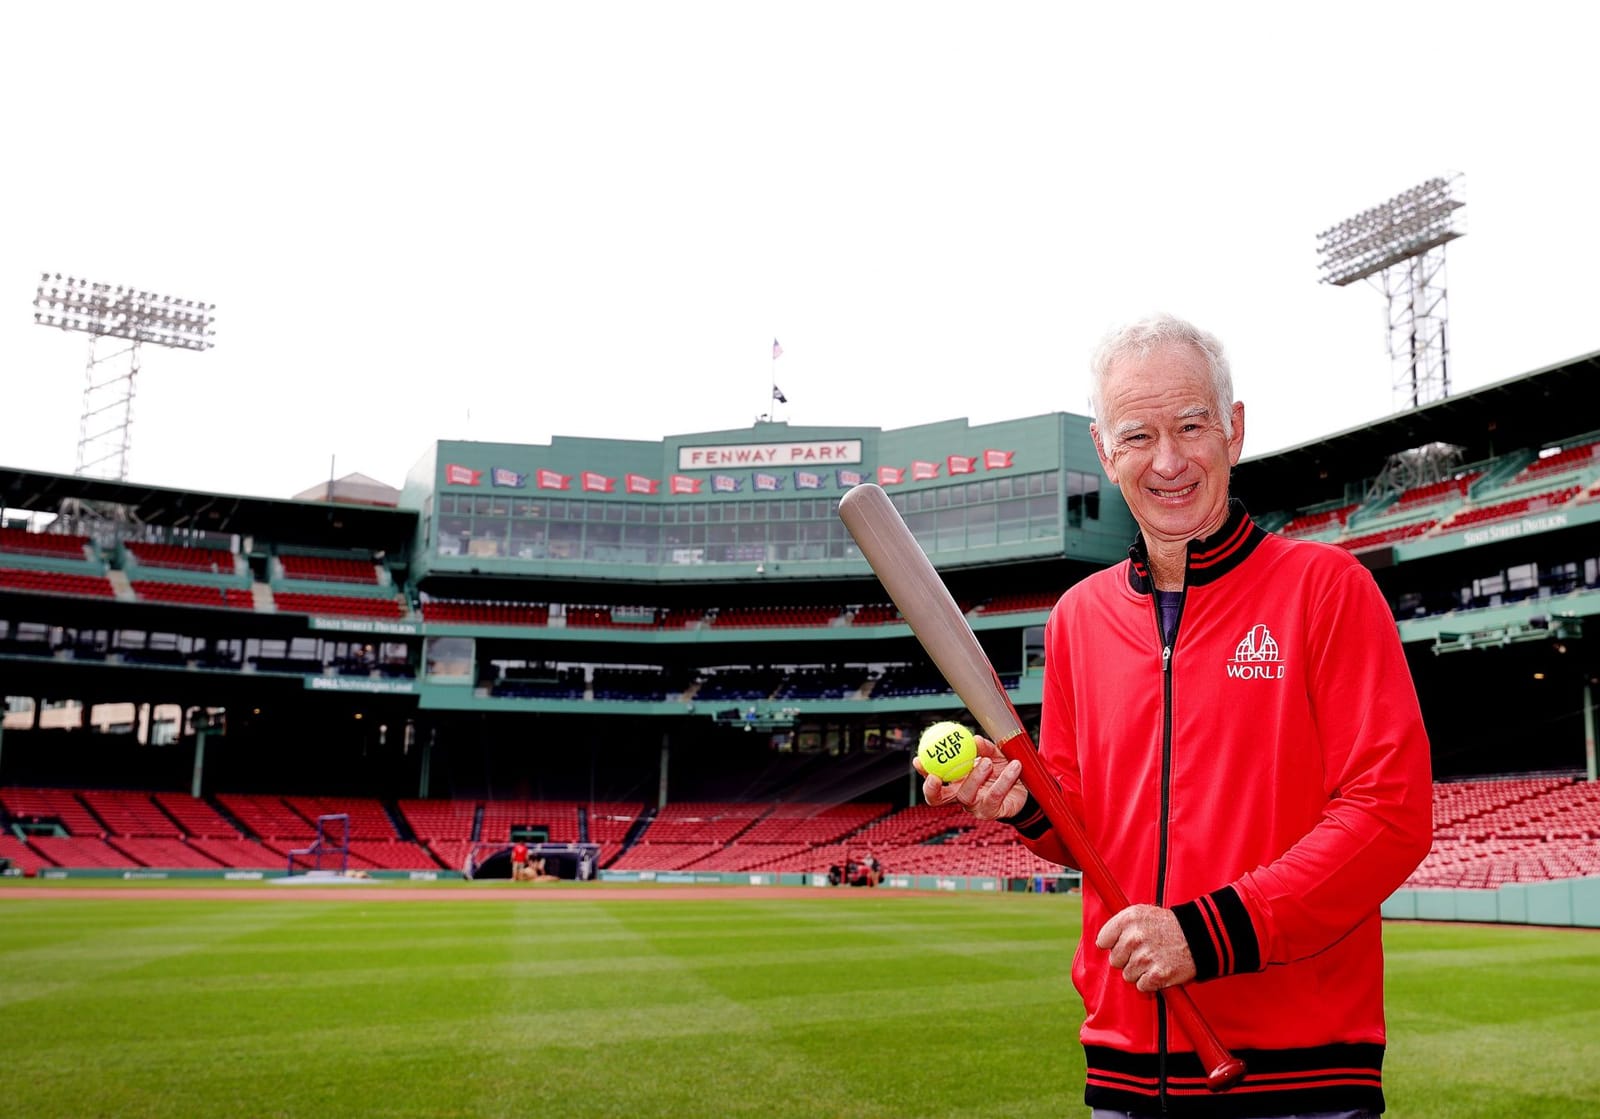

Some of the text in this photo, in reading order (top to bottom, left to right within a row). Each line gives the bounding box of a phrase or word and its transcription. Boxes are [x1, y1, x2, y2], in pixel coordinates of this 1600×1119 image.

[691, 445, 848, 465] FENWAY PARK
[1226, 664, 1285, 680] WORLD
[926, 731, 965, 759] LAVER
[937, 742, 962, 764] CUP
